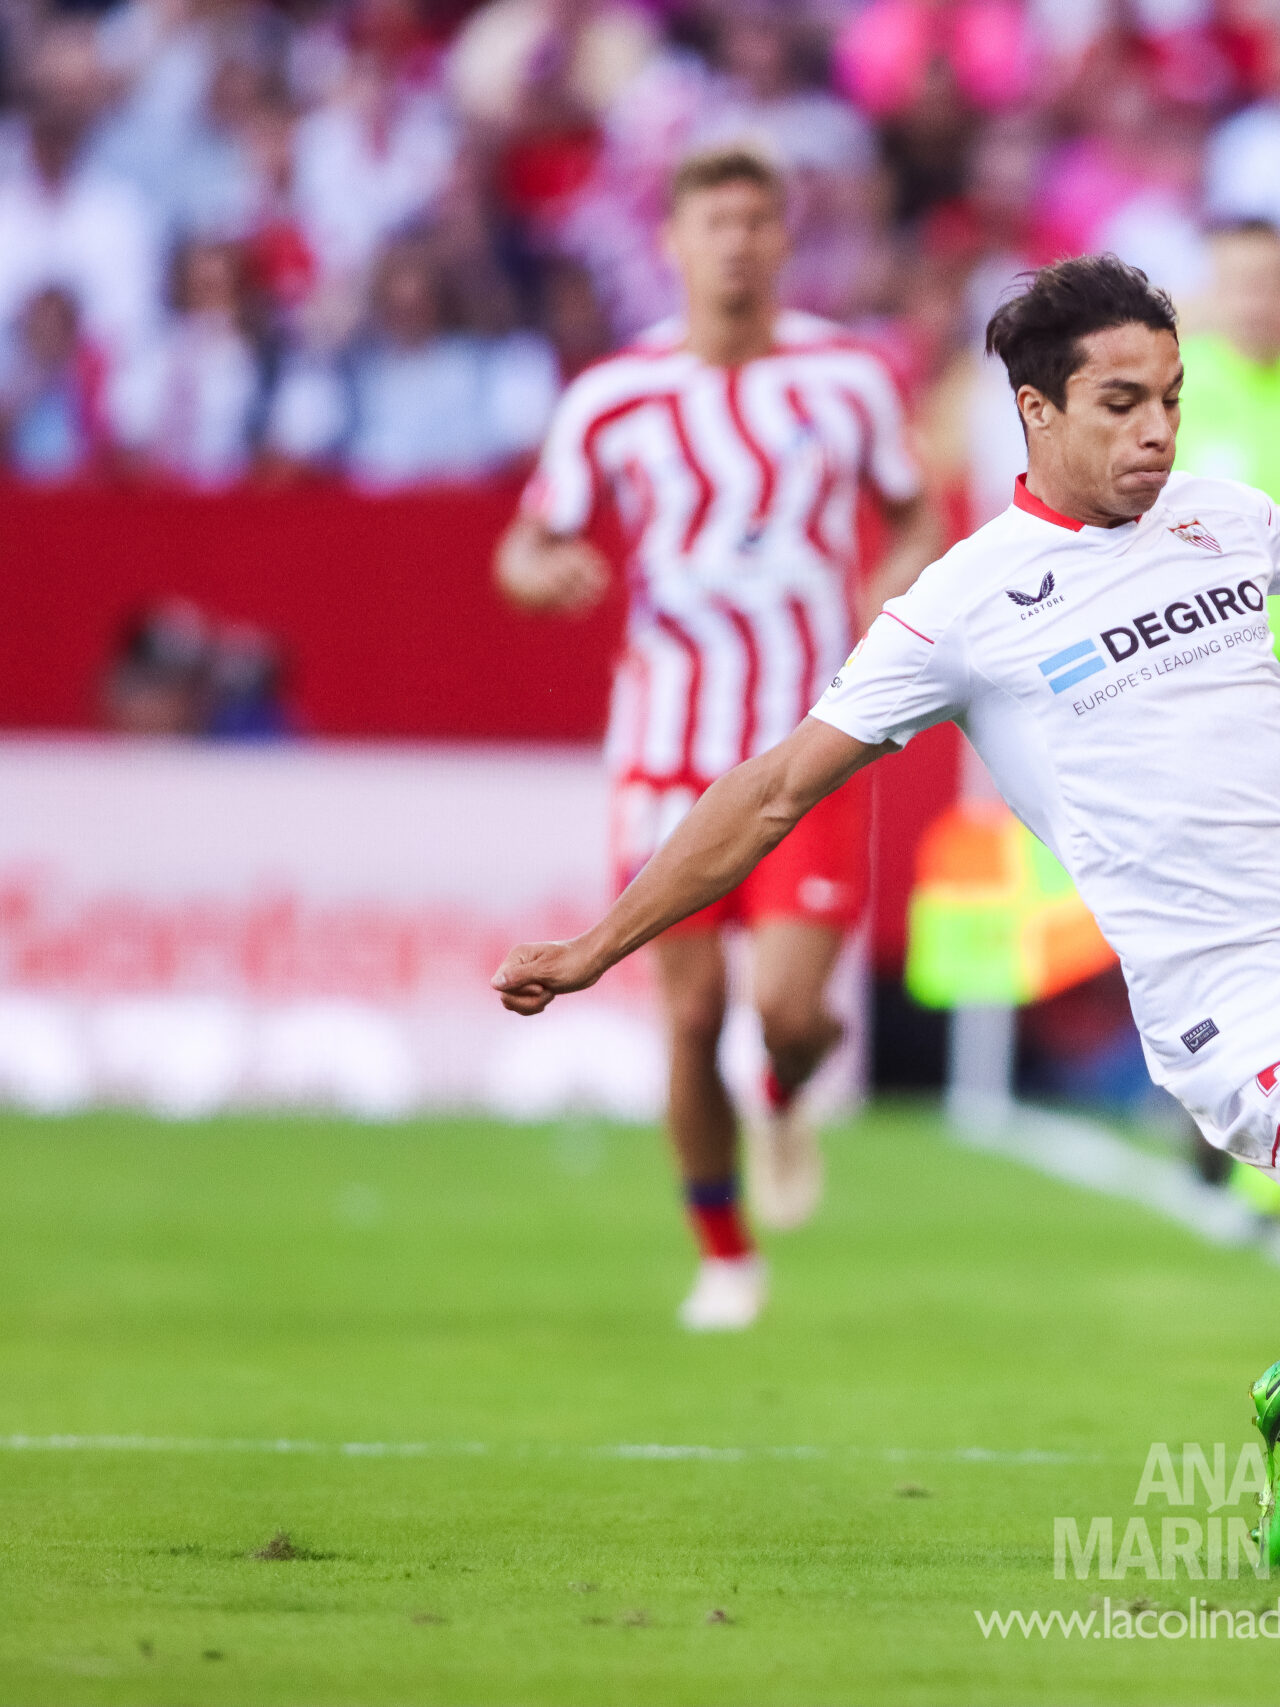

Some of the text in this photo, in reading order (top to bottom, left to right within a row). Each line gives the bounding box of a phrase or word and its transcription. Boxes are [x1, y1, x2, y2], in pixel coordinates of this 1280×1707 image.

[1020, 595, 1066, 621] CASTORE
[1100, 579, 1264, 663] DEGIRO
[1155, 639, 1222, 676] LEADING
